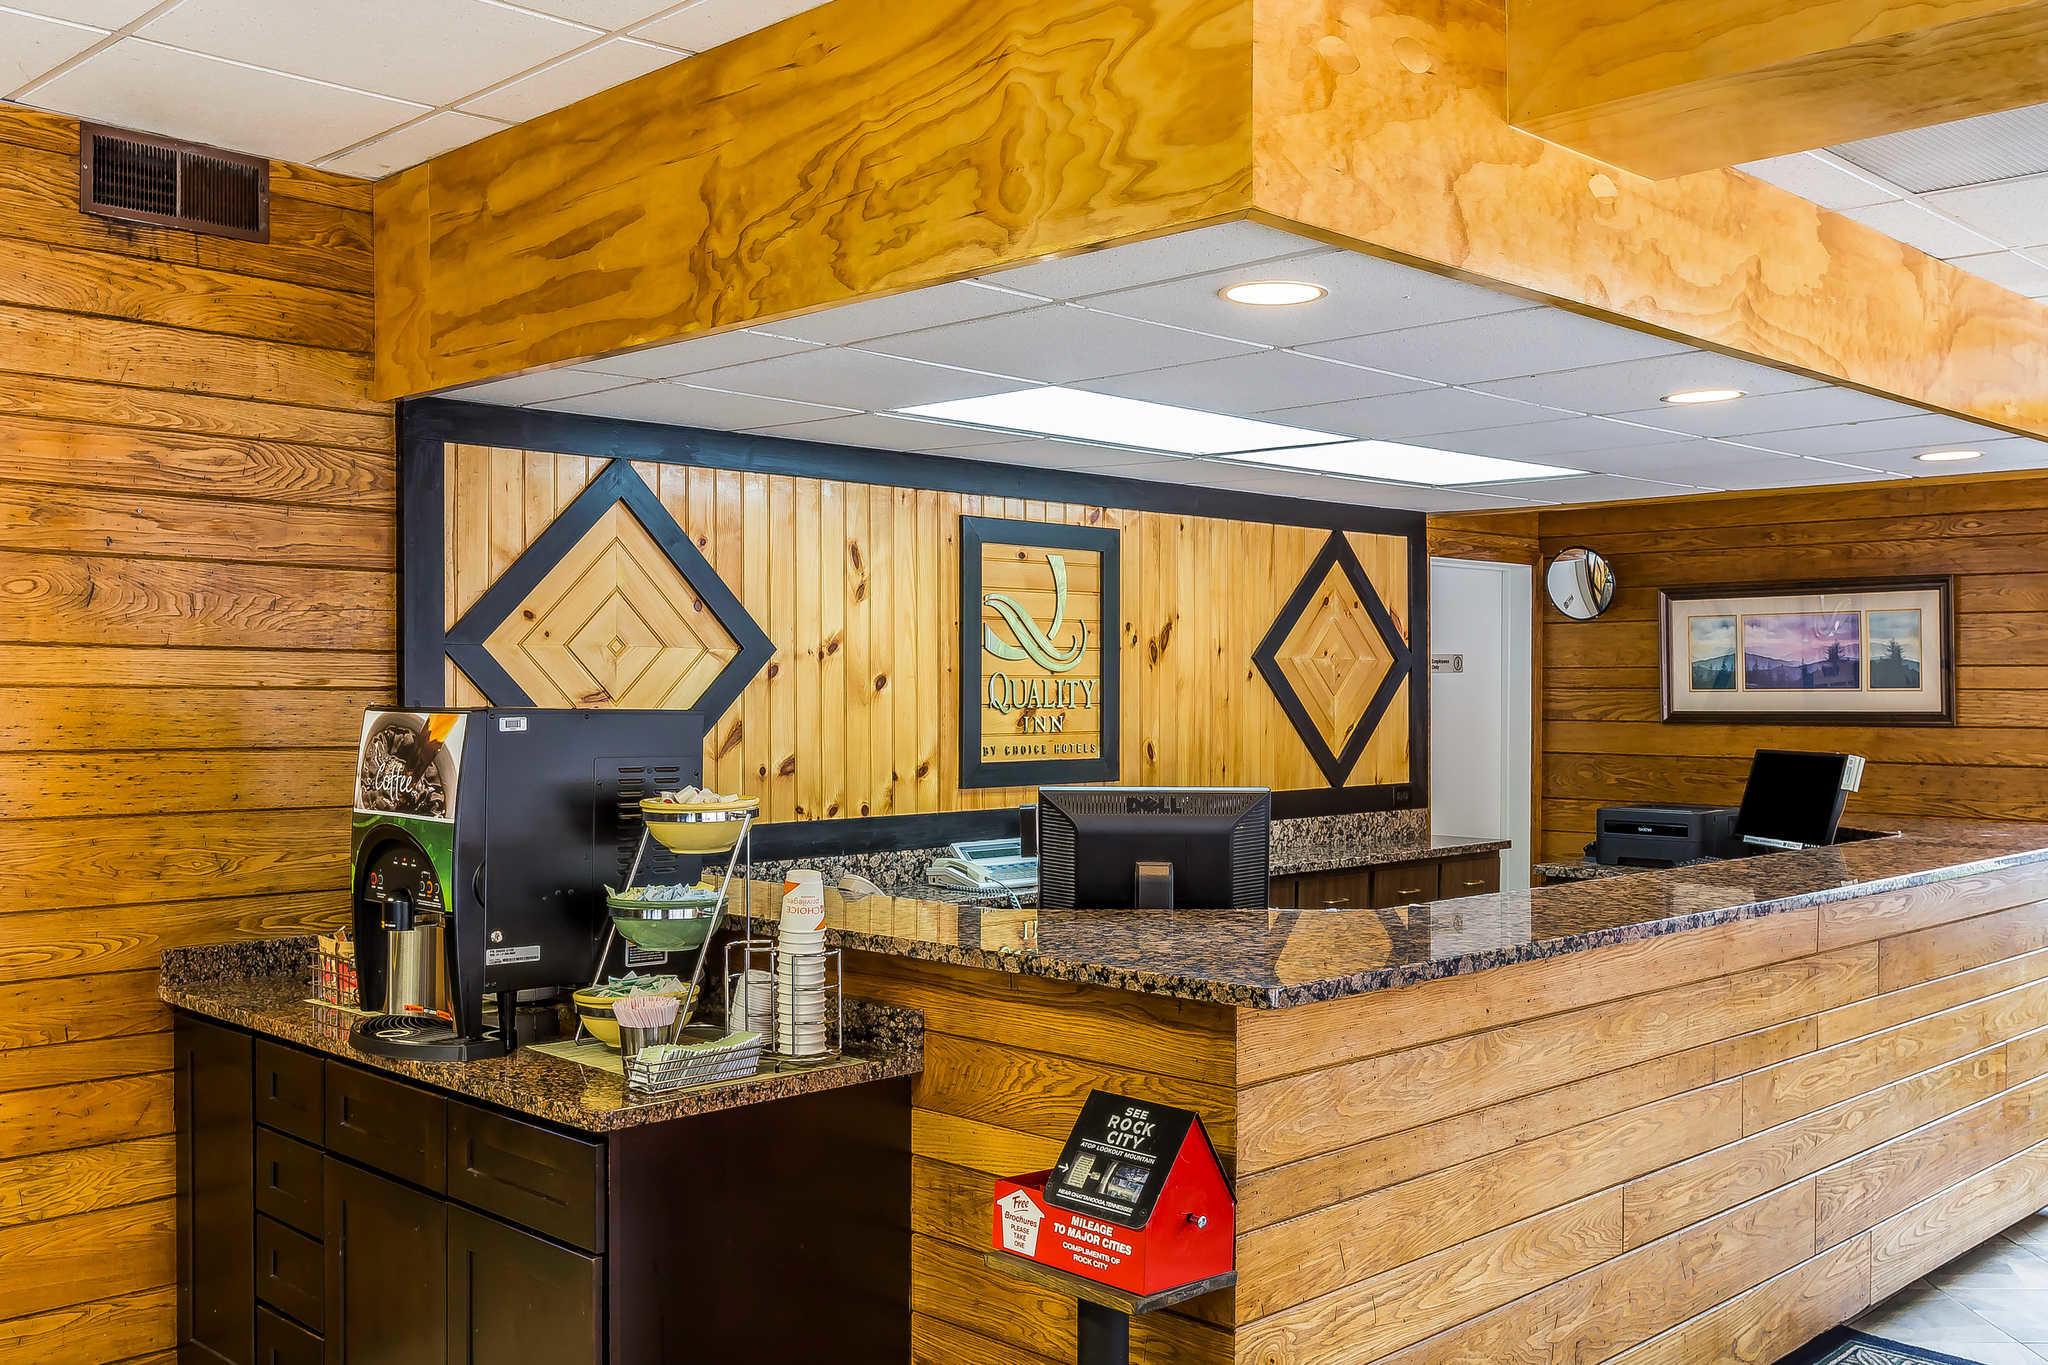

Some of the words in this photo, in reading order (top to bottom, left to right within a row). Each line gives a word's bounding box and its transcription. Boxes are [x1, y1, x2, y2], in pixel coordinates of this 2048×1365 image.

[988, 672, 1096, 714] QUALITY
[1023, 715, 1064, 733] INN
[983, 746, 996, 756] BY
[1004, 744, 1046, 756] CHOICE
[1054, 743, 1096, 754] HOTELS
[375, 762, 413, 801] Coffee
[1127, 796, 1183, 814] DELL
[786, 905, 820, 915] CHOICE
[1125, 1107, 1149, 1120] SEE
[1107, 1114, 1156, 1137] ROCK
[1107, 1131, 1145, 1149] CITY
[1080, 1141, 1096, 1149] ATOP
[1096, 1145, 1124, 1157] LOOKOUT
[1124, 1152, 1156, 1165] MOUNTAIN
[1012, 1196, 1029, 1209] Free
[1058, 1188, 1071, 1197] NEAR
[1106, 1201, 1134, 1214] TENNESSEE
[1005, 1210, 1037, 1228] Brochures
[1071, 1215, 1114, 1237] MILEAGE
[1011, 1223, 1029, 1235] PLEASE
[1013, 1232, 1026, 1241] TAKE
[1014, 1240, 1025, 1249] ONE
[1053, 1222, 1066, 1235] TO
[1067, 1226, 1100, 1246] MAJOR
[1101, 1237, 1132, 1256] CITIES
[1062, 1241, 1110, 1262] COMPLIMENTS
[1110, 1256, 1121, 1265] OF
[1072, 1253, 1093, 1266] ROCK
[1092, 1260, 1109, 1270] CITY
